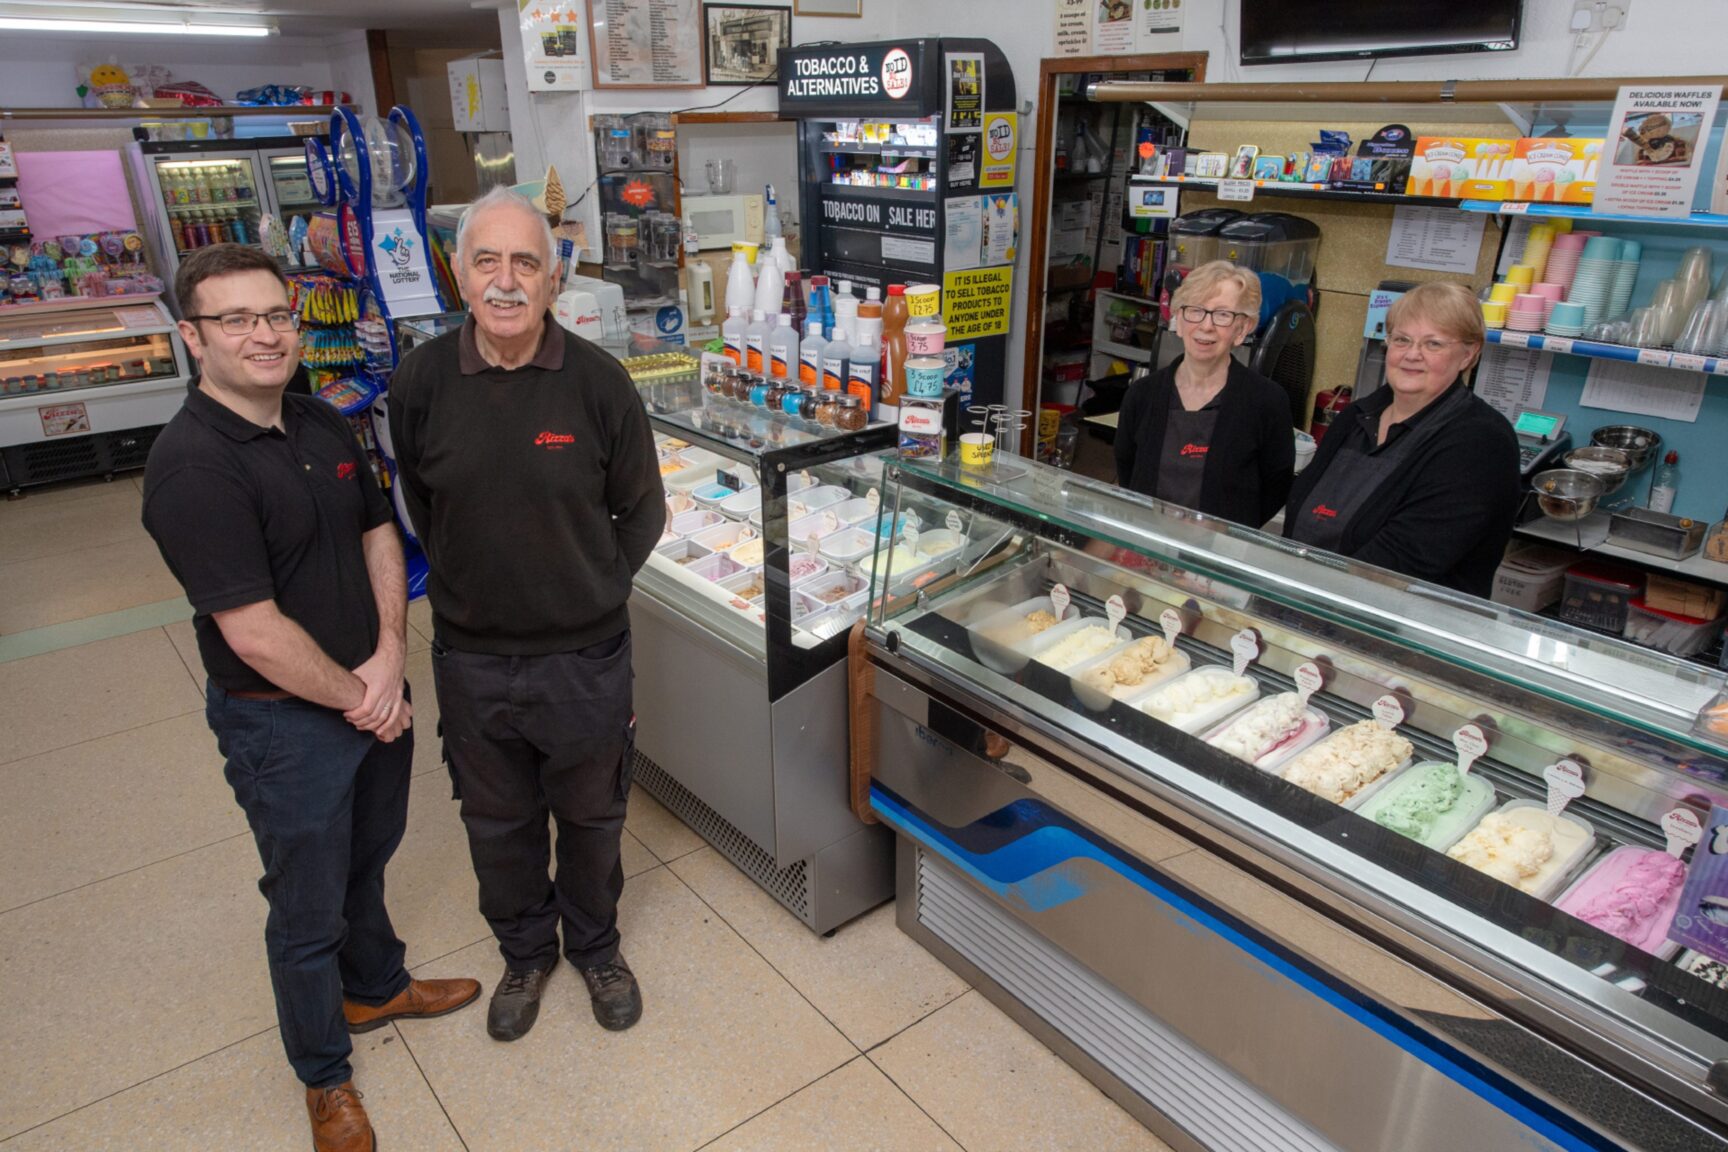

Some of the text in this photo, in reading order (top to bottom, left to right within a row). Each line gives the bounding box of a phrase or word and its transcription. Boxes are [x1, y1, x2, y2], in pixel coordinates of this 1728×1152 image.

[794, 56, 869, 75] TOBACCO &
[885, 62, 894, 72] NO
[788, 77, 878, 96] ALTERNATIVES
[823, 200, 864, 220] TOBACCO
[866, 204, 880, 223] ON
[888, 207, 912, 226] SALE
[916, 209, 935, 228] HER
[954, 271, 1002, 286] IT IS ILLEGAL
[946, 284, 1009, 298] TO SELL TOBACCO
[914, 304, 933, 315] £2.75
[952, 297, 1002, 311] PRODUCTS TO
[948, 309, 1004, 324] ANYONE UNDER
[951, 321, 1001, 335] THE AGE OF 18
[914, 381, 938, 393] £4.75
